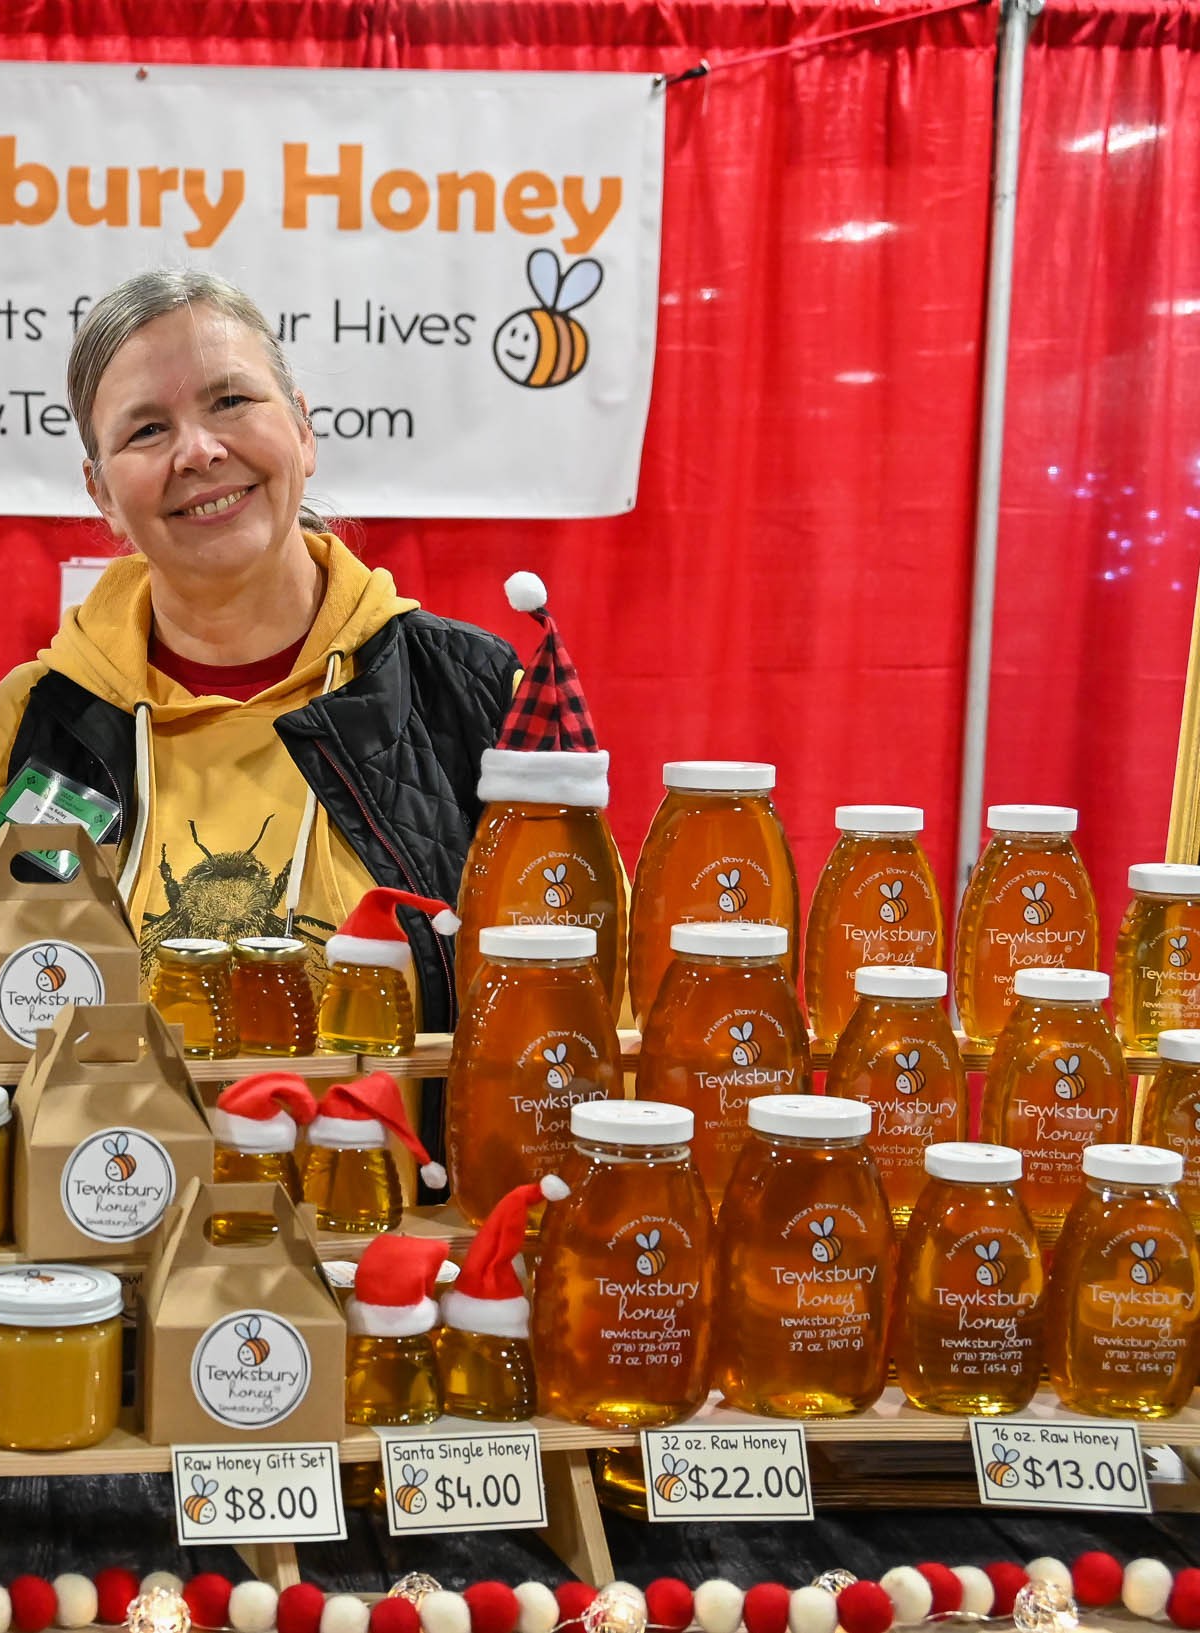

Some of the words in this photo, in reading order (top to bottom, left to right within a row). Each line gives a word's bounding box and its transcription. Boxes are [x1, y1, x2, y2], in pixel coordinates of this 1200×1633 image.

[281, 141, 624, 255] Honey
[333, 298, 477, 346] Hives
[722, 856, 745, 864] Raw
[747, 858, 771, 887] Honey
[840, 923, 937, 946] Tewksbury
[985, 927, 1086, 946] Tewksbury
[1140, 966, 1200, 981] Tewksbu
[29, 1004, 55, 1022] hon
[693, 1067, 795, 1088] Tewksbury
[1012, 1099, 1118, 1125] Tewksbury
[74, 1180, 163, 1201] Tewksbury
[770, 1264, 877, 1285] Tewksbury
[594, 1278, 700, 1299] Tewksbury
[934, 1287, 1039, 1309] Tewksbury
[1088, 1284, 1195, 1310] Tewksbury
[780, 1311, 871, 1328] tewksbury.com
[601, 1328, 691, 1342] tewksbury.com
[941, 1337, 1032, 1350] tewksbury.com
[205, 1364, 299, 1387] Tewksbury
[660, 1435, 680, 1450] 32
[684, 1440, 707, 1450] oz.
[710, 1435, 739, 1450] Raw
[743, 1435, 787, 1455] Honey
[992, 1427, 1009, 1442] 16
[1013, 1430, 1036, 1443] oz.
[1040, 1429, 1069, 1444] Raw
[1073, 1431, 1119, 1451] Honey
[183, 1455, 212, 1471] Raw
[216, 1455, 261, 1476] Honey
[266, 1452, 296, 1469] Gift
[300, 1451, 326, 1468] Set
[392, 1443, 435, 1461] Santa
[438, 1441, 484, 1464] Single
[487, 1441, 530, 1461] Honey
[688, 1464, 805, 1501] $22.00
[1022, 1456, 1138, 1492] $13.00
[435, 1473, 521, 1512] $4.00
[224, 1485, 318, 1524] $8.00
